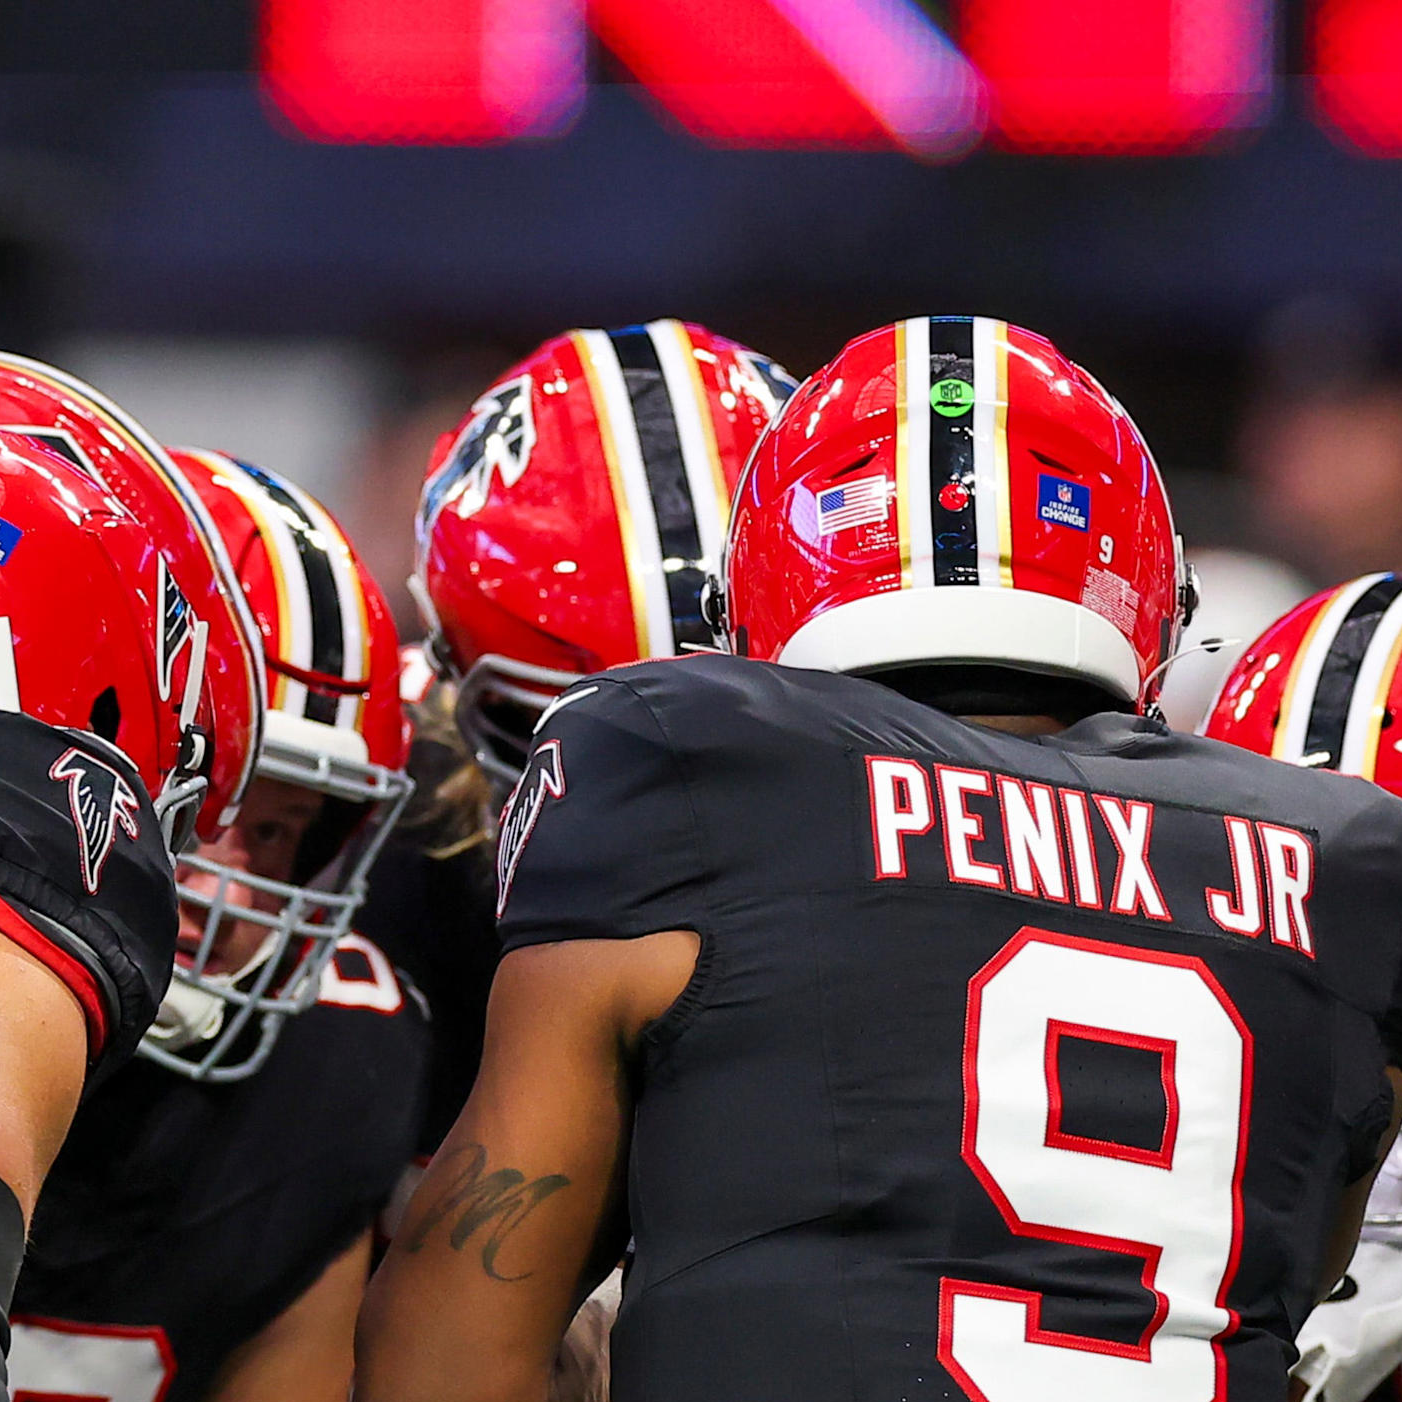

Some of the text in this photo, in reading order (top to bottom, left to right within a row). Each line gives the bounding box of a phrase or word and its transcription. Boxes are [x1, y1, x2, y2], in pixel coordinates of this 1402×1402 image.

[1041, 505, 1086, 529] CHANGE
[1098, 534, 1115, 565] 9
[864, 754, 1317, 959] PENIX JR
